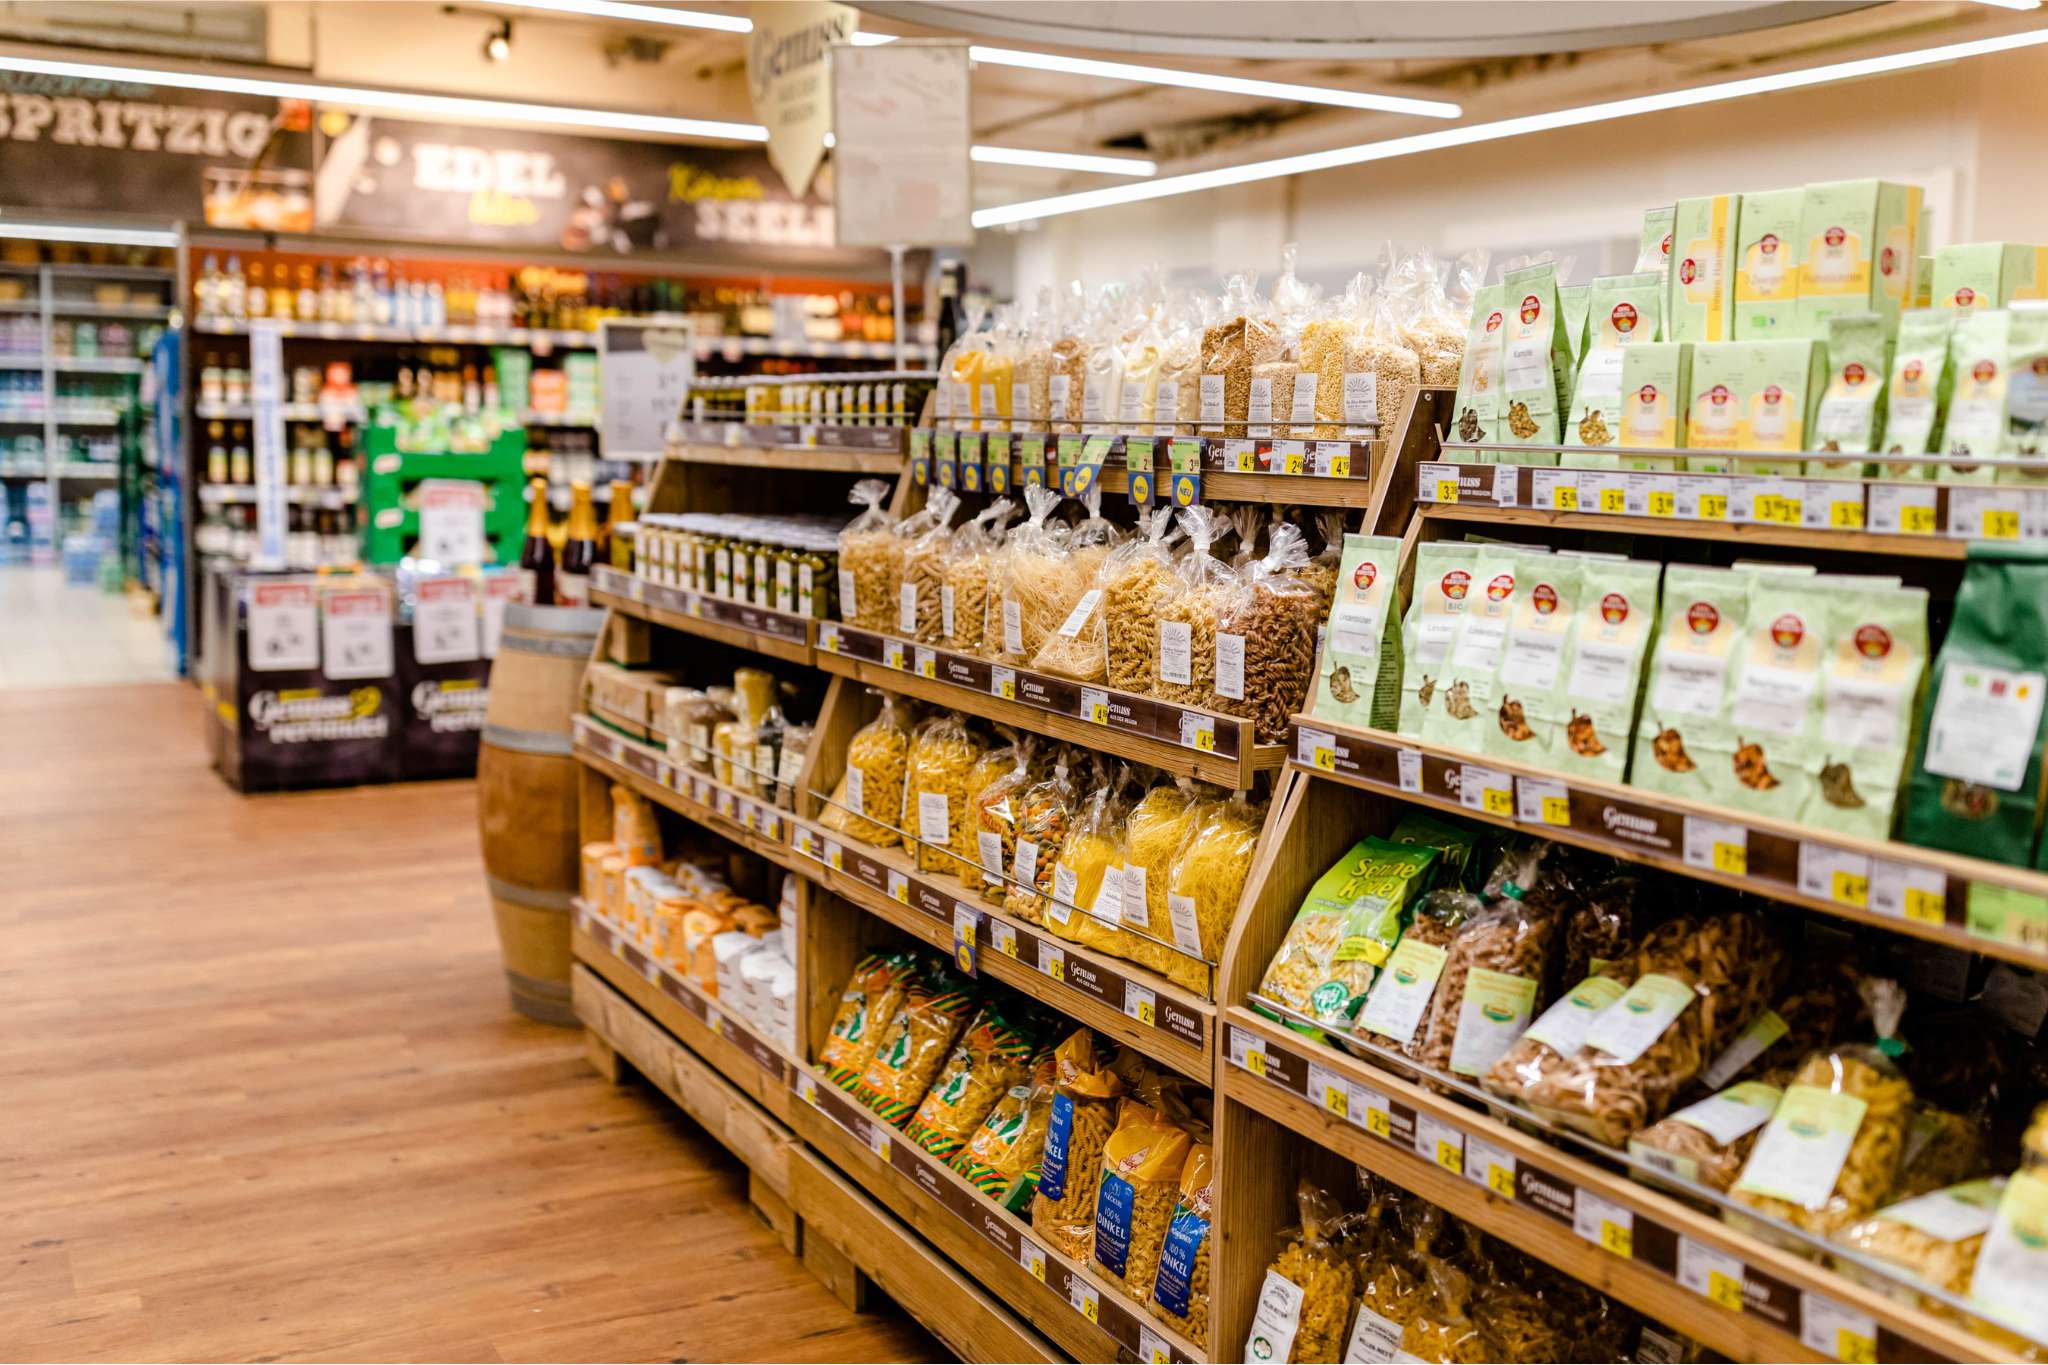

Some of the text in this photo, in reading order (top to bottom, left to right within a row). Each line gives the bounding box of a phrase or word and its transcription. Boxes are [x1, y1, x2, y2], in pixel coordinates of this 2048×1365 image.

[1180, 486, 1194, 498] NEU
[1457, 477, 1481, 488] nuss
[1070, 961, 1097, 983] Genuss
[1165, 1005, 1196, 1029] Genuss
[1521, 1171, 1572, 1205] Genuss
[1097, 1215, 1126, 1240] DINKEL
[1161, 1249, 1188, 1277] DINKEL
